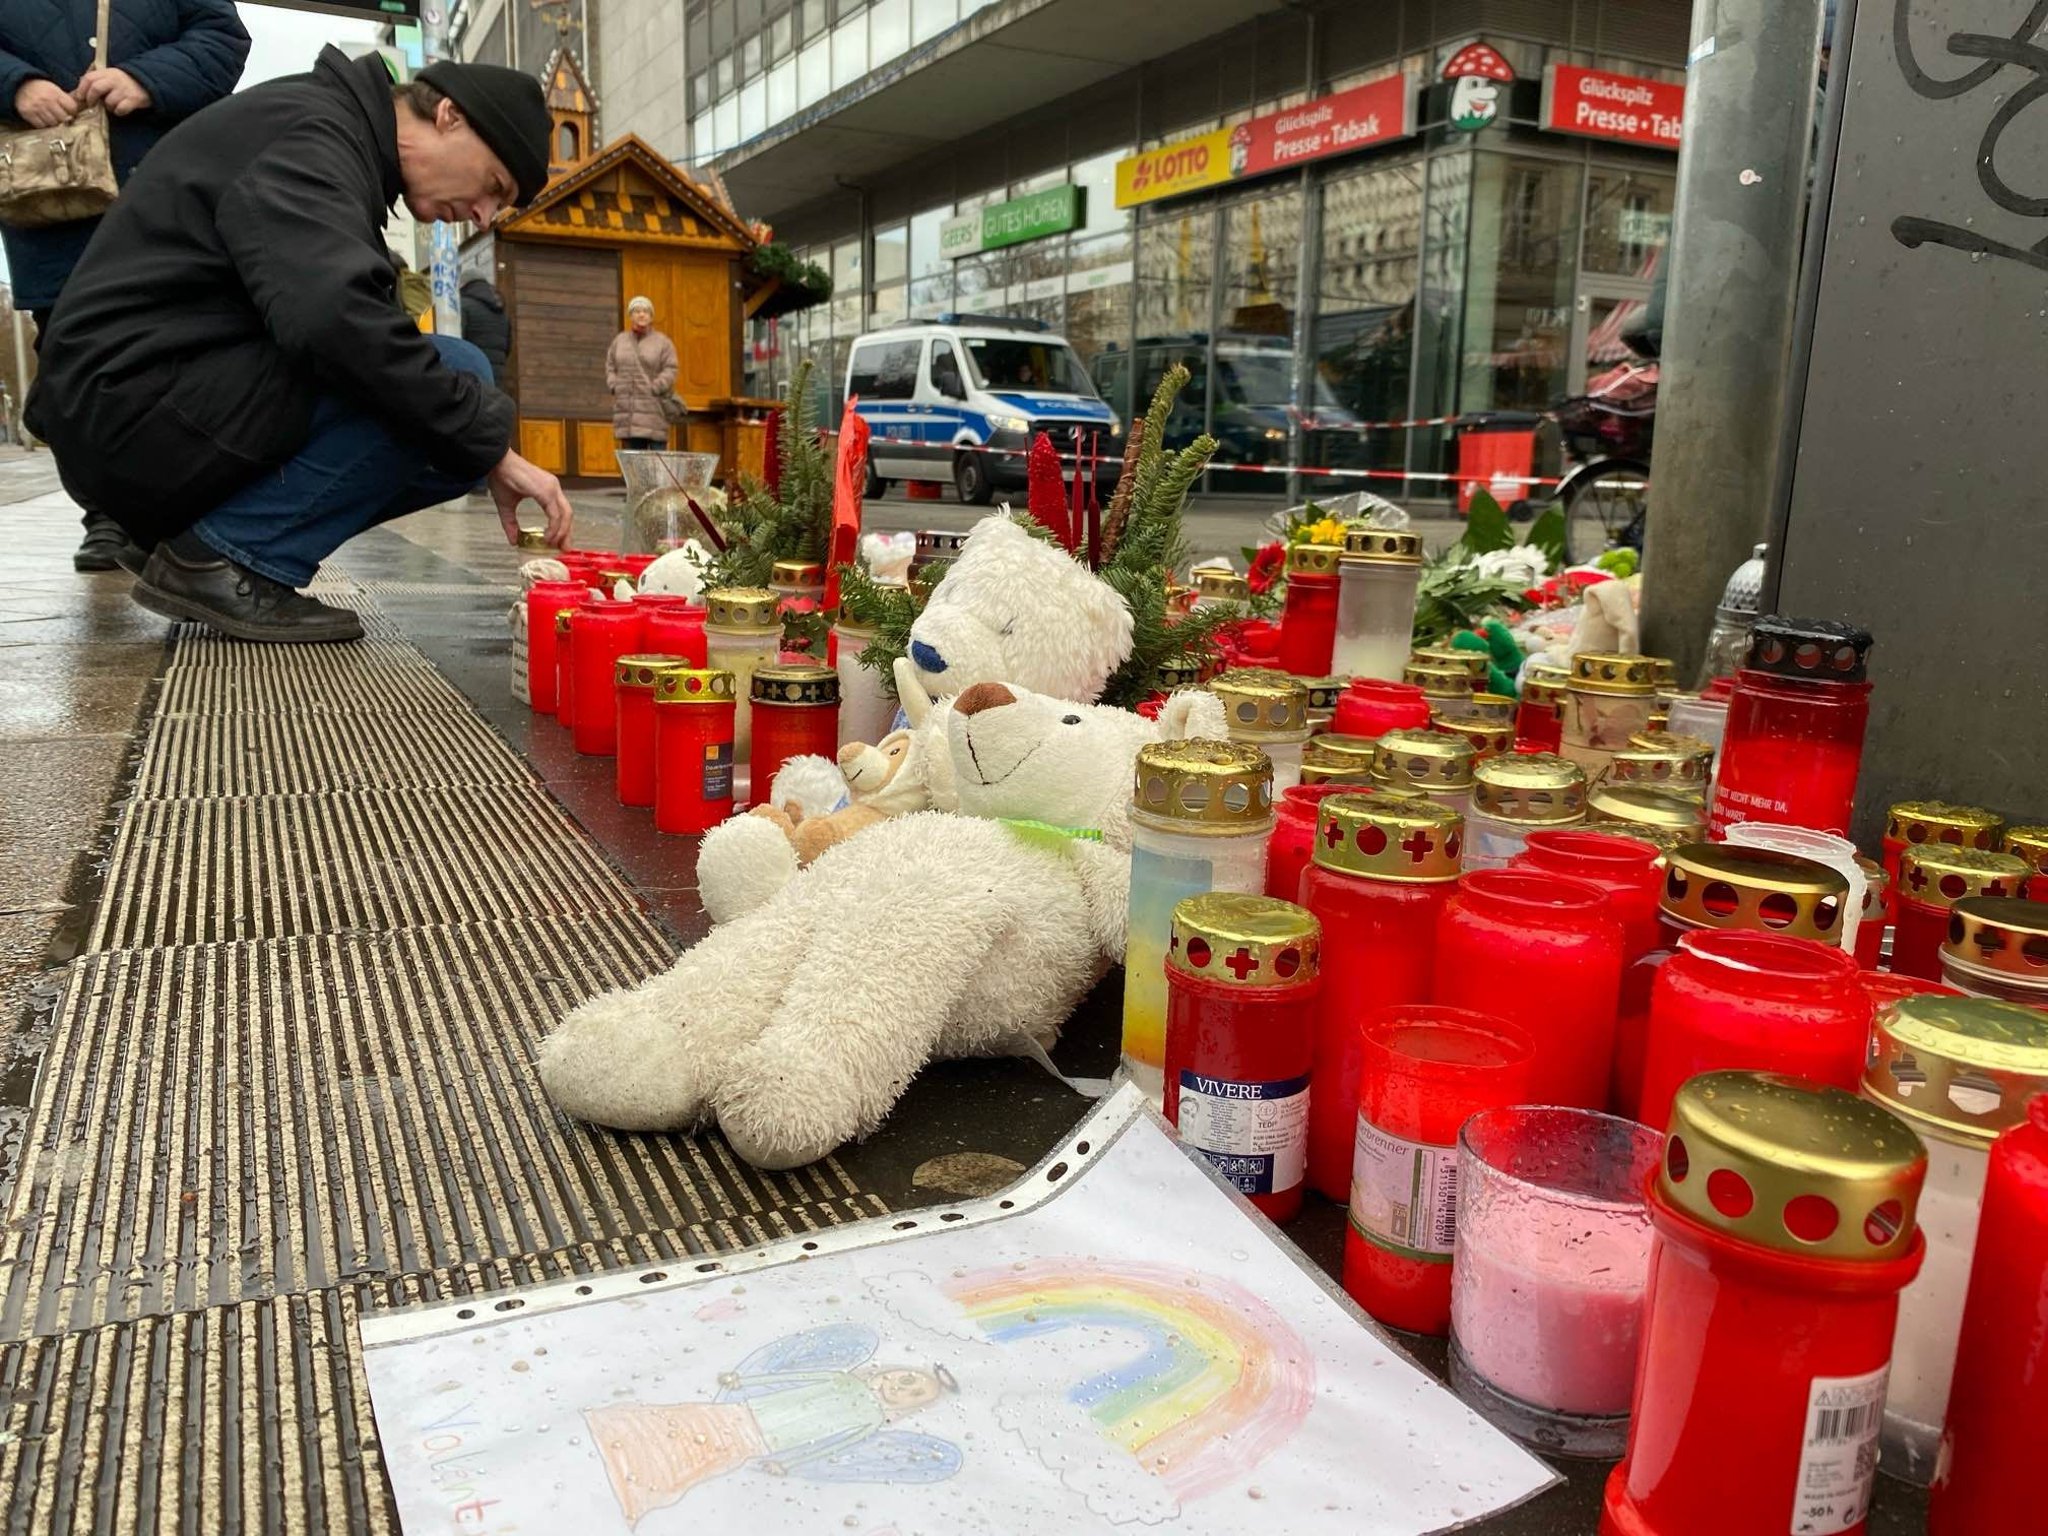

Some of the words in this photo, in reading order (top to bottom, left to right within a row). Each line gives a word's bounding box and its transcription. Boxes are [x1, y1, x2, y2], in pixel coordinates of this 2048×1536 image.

[1579, 76, 1654, 106] Glückspilz
[1275, 104, 1333, 134] Glückspilz
[1576, 101, 1639, 133] Presse
[1651, 114, 1683, 139] Tab
[1272, 132, 1321, 162] Presse
[1331, 113, 1380, 145] Tabak
[1153, 145, 1208, 183] LOTTO
[984, 210, 1021, 239] GUTES
[1023, 199, 1069, 227] HÖREN
[1750, 796, 1772, 810] MEHR
[1196, 1077, 1263, 1100] VIVERE
